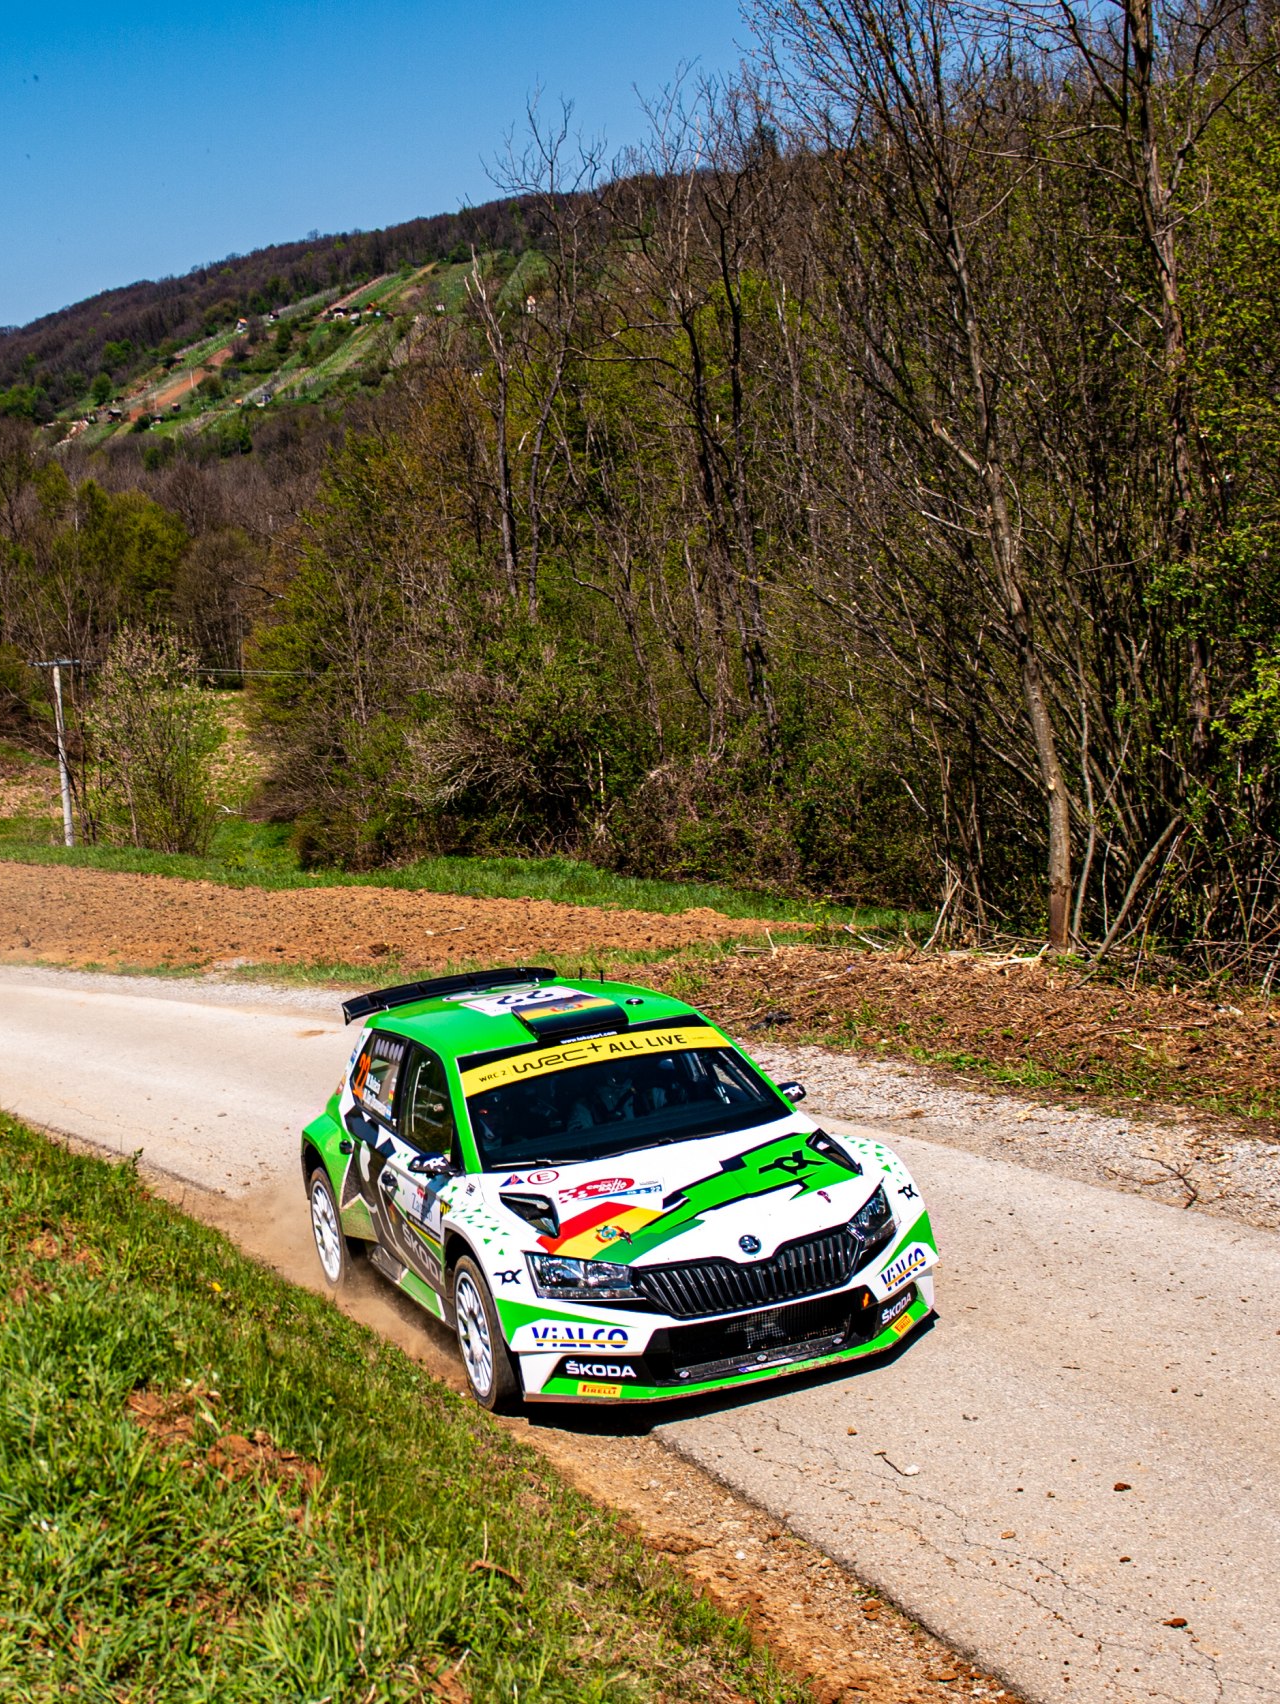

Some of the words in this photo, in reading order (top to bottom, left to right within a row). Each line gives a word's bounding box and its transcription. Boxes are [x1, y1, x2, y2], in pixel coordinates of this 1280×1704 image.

[478, 1073, 499, 1083] WRC
[501, 1070, 508, 1078] 2
[609, 1040, 643, 1053] ALL
[645, 1034, 687, 1048] LIVE
[352, 1053, 372, 1101] 22
[881, 1291, 913, 1325] ŠKODA
[565, 1360, 637, 1378] ŠKODA
[582, 1384, 618, 1395] PIRELLI
